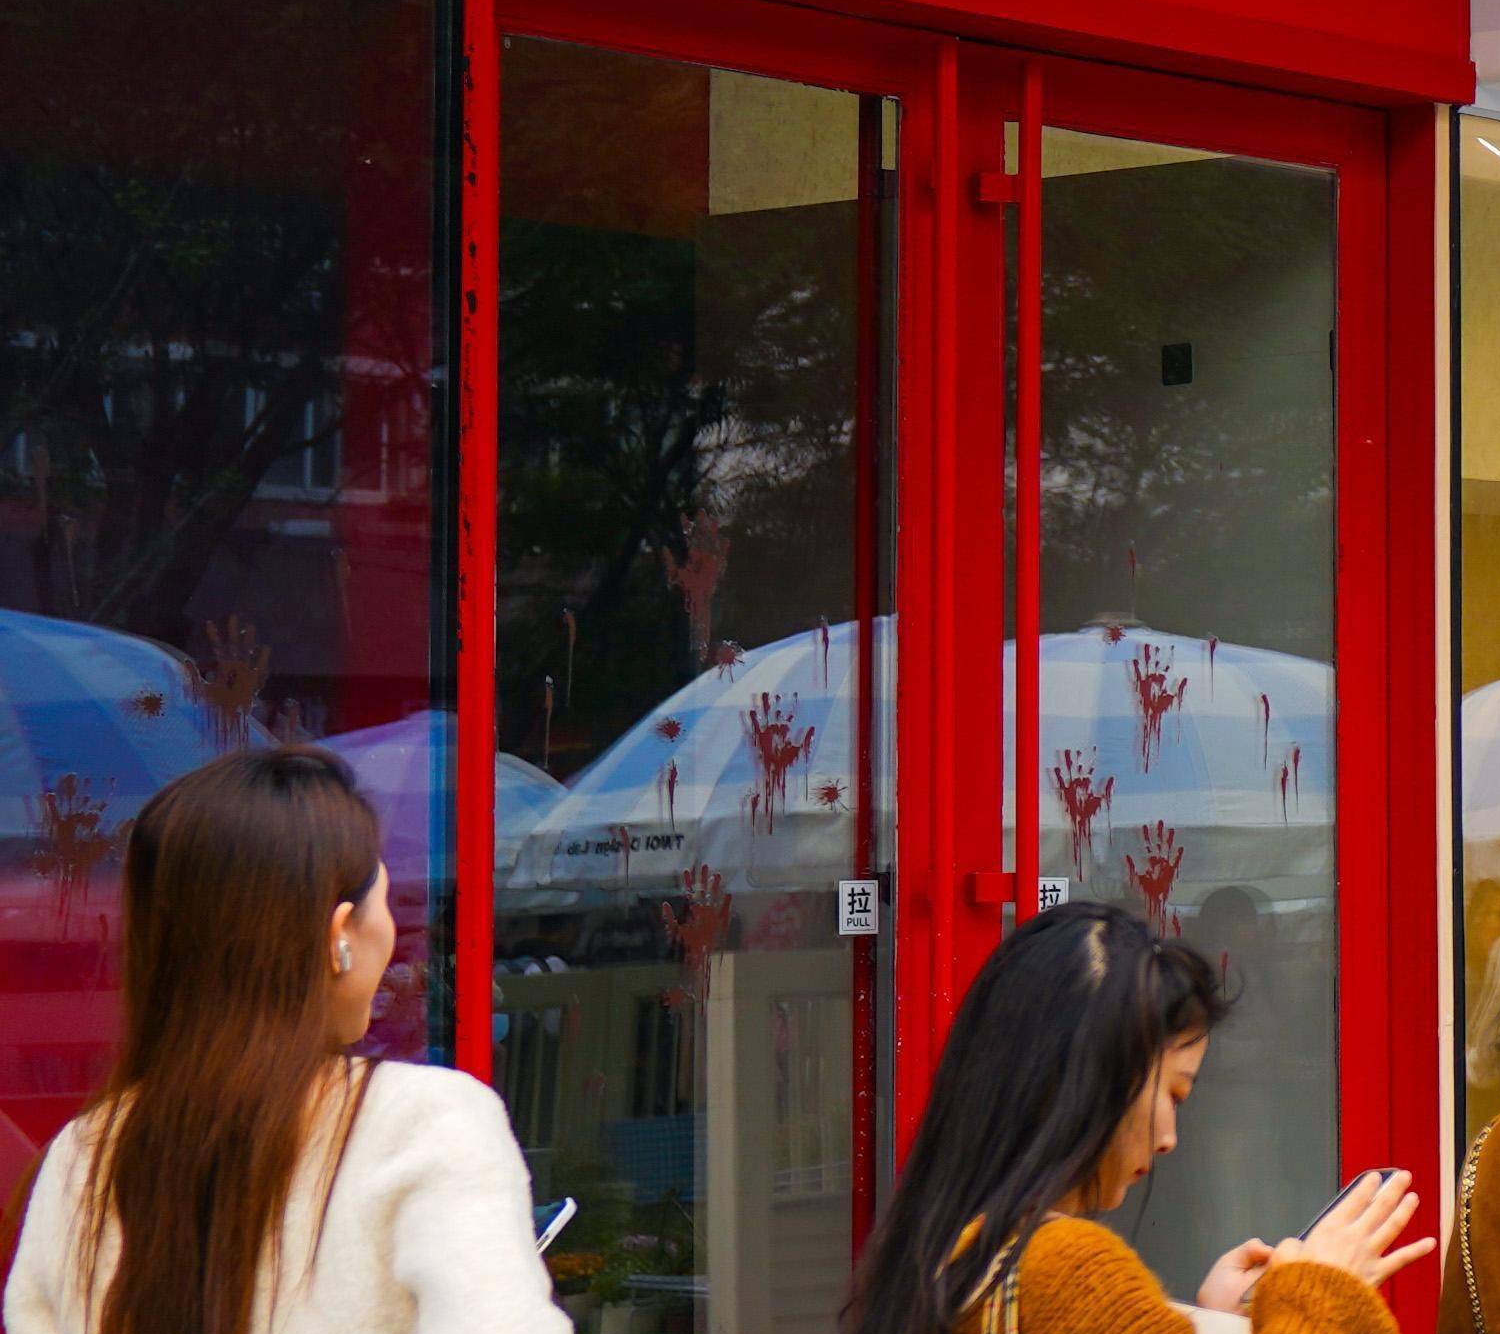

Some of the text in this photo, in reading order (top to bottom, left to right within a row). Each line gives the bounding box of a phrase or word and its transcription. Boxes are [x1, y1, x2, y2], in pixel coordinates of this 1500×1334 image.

[848, 887, 871, 915] 拉
[1039, 883, 1061, 910] 拉
[846, 917, 871, 927] PULL
